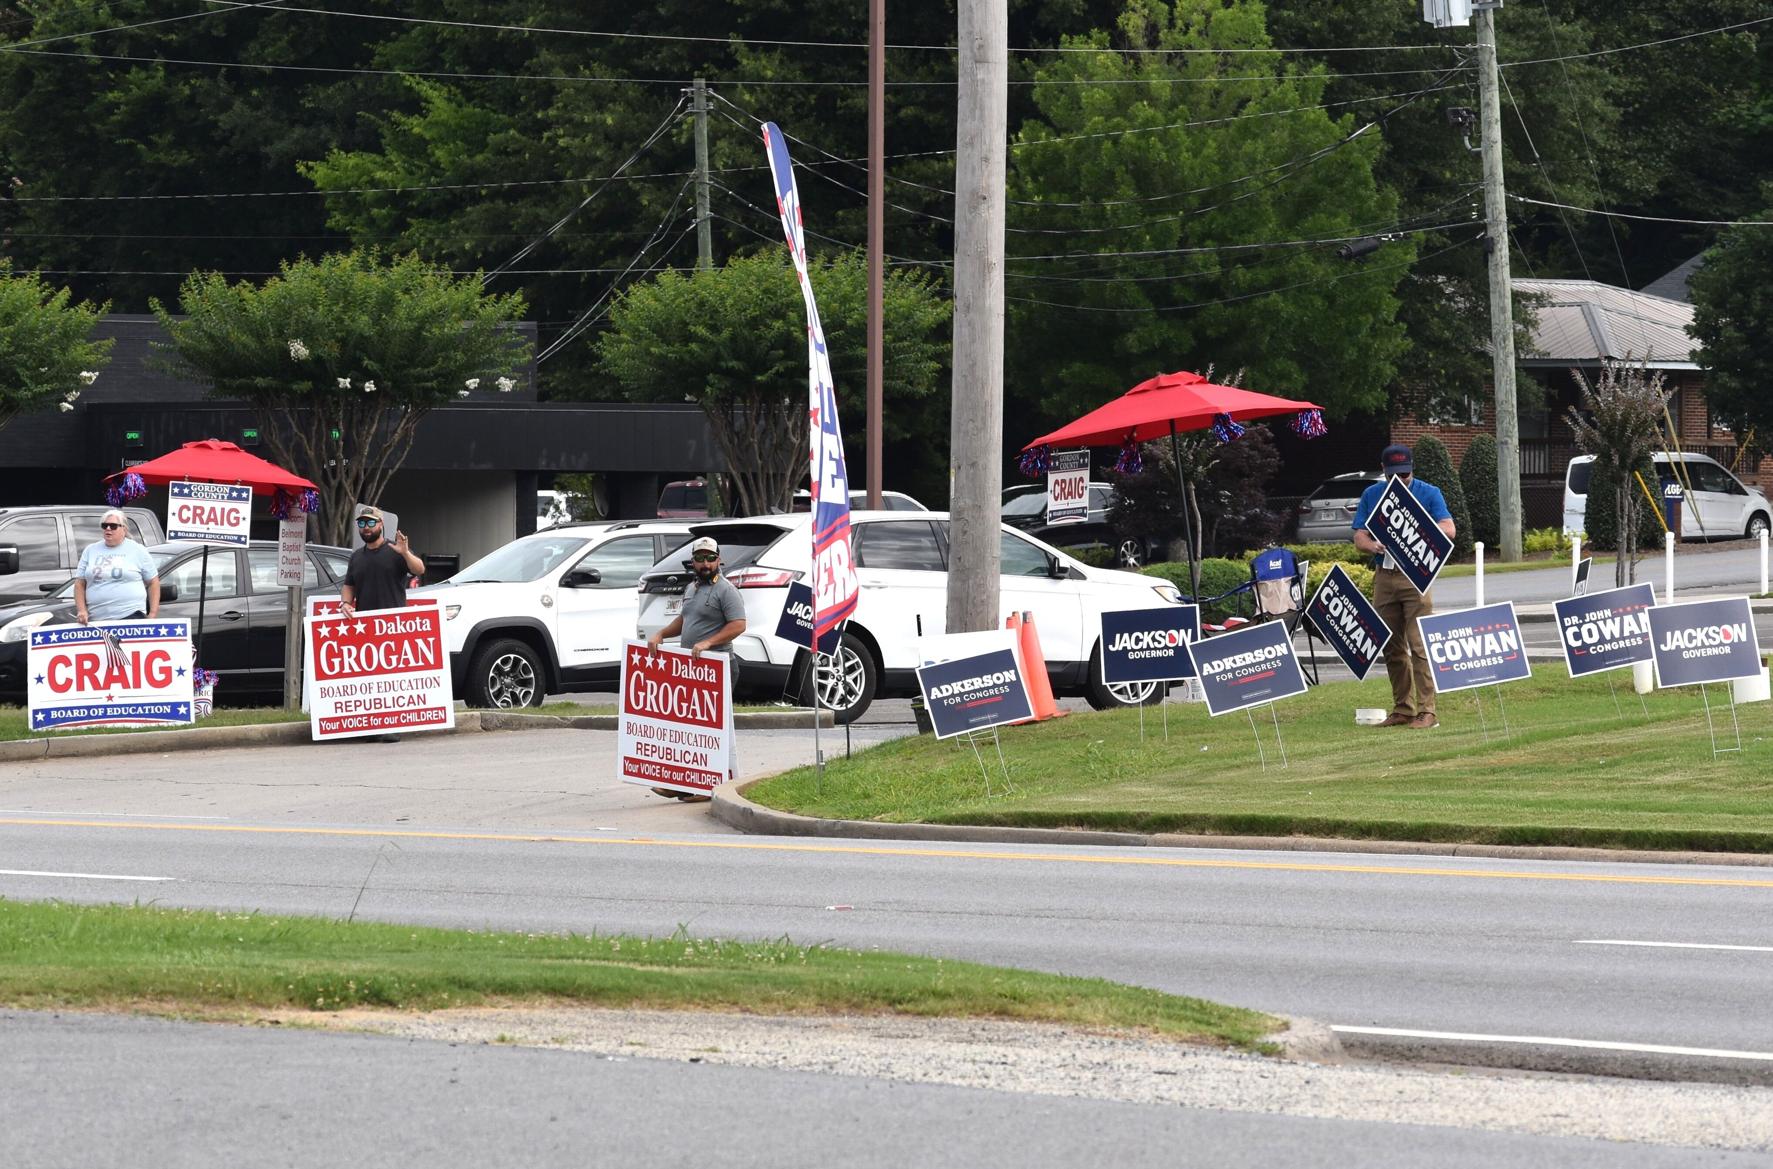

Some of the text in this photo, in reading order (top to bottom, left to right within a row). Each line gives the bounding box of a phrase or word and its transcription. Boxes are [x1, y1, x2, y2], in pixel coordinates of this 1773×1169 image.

[191, 485, 230, 493] GORDON
[191, 491, 229, 500] COUNTY
[1053, 476, 1084, 501] CRAIG
[177, 504, 241, 527] CRAIG
[1389, 491, 1420, 528] DR. JOHN
[281, 529, 304, 539] Belmont
[1381, 499, 1440, 573] COWAN
[282, 543, 301, 553] Baptist
[1387, 526, 1420, 566] CONGRESS
[281, 556, 301, 565] Church
[280, 570, 301, 581] Parking
[1328, 579, 1359, 616] DR. JOHN
[374, 616, 431, 636] Dakota
[1320, 586, 1378, 660] COWAN
[1564, 608, 1612, 626] DR. JOHN
[110, 627, 155, 637] COUNTY
[1108, 628, 1192, 651] JACKSON
[1325, 614, 1357, 654] CONGRESS
[1428, 627, 1473, 642] DR. JOHN
[1660, 623, 1747, 651] JACKSON
[320, 638, 435, 676] GROGAN
[1128, 649, 1174, 659] GOVERNOR
[1430, 629, 1519, 664] COWAN
[1589, 637, 1643, 654] CONGRESS
[1682, 646, 1731, 659] GOVERNOR
[672, 657, 716, 683] Dakota
[1202, 642, 1289, 676] ADKERSON
[1215, 659, 1282, 682] FOR CONGRESS
[1453, 656, 1504, 672] CONGRESS
[47, 650, 173, 693] CRAIG
[320, 676, 441, 699] BOARD OF EDUCATION
[930, 669, 1017, 700] ADKERSON
[944, 685, 1010, 706] FOR CONGRESS
[334, 694, 427, 714] REPUBLICAN
[629, 671, 718, 723] GROGAN
[51, 705, 171, 719] BOARD OF EDUCATION
[320, 710, 445, 731] Your VOICE for our CHILDREN
[626, 721, 720, 751] BOARD OF EDUCATION
[636, 741, 708, 767] REPUBLICAN
[624, 759, 721, 787] Your VOICE for our CHILDREN
